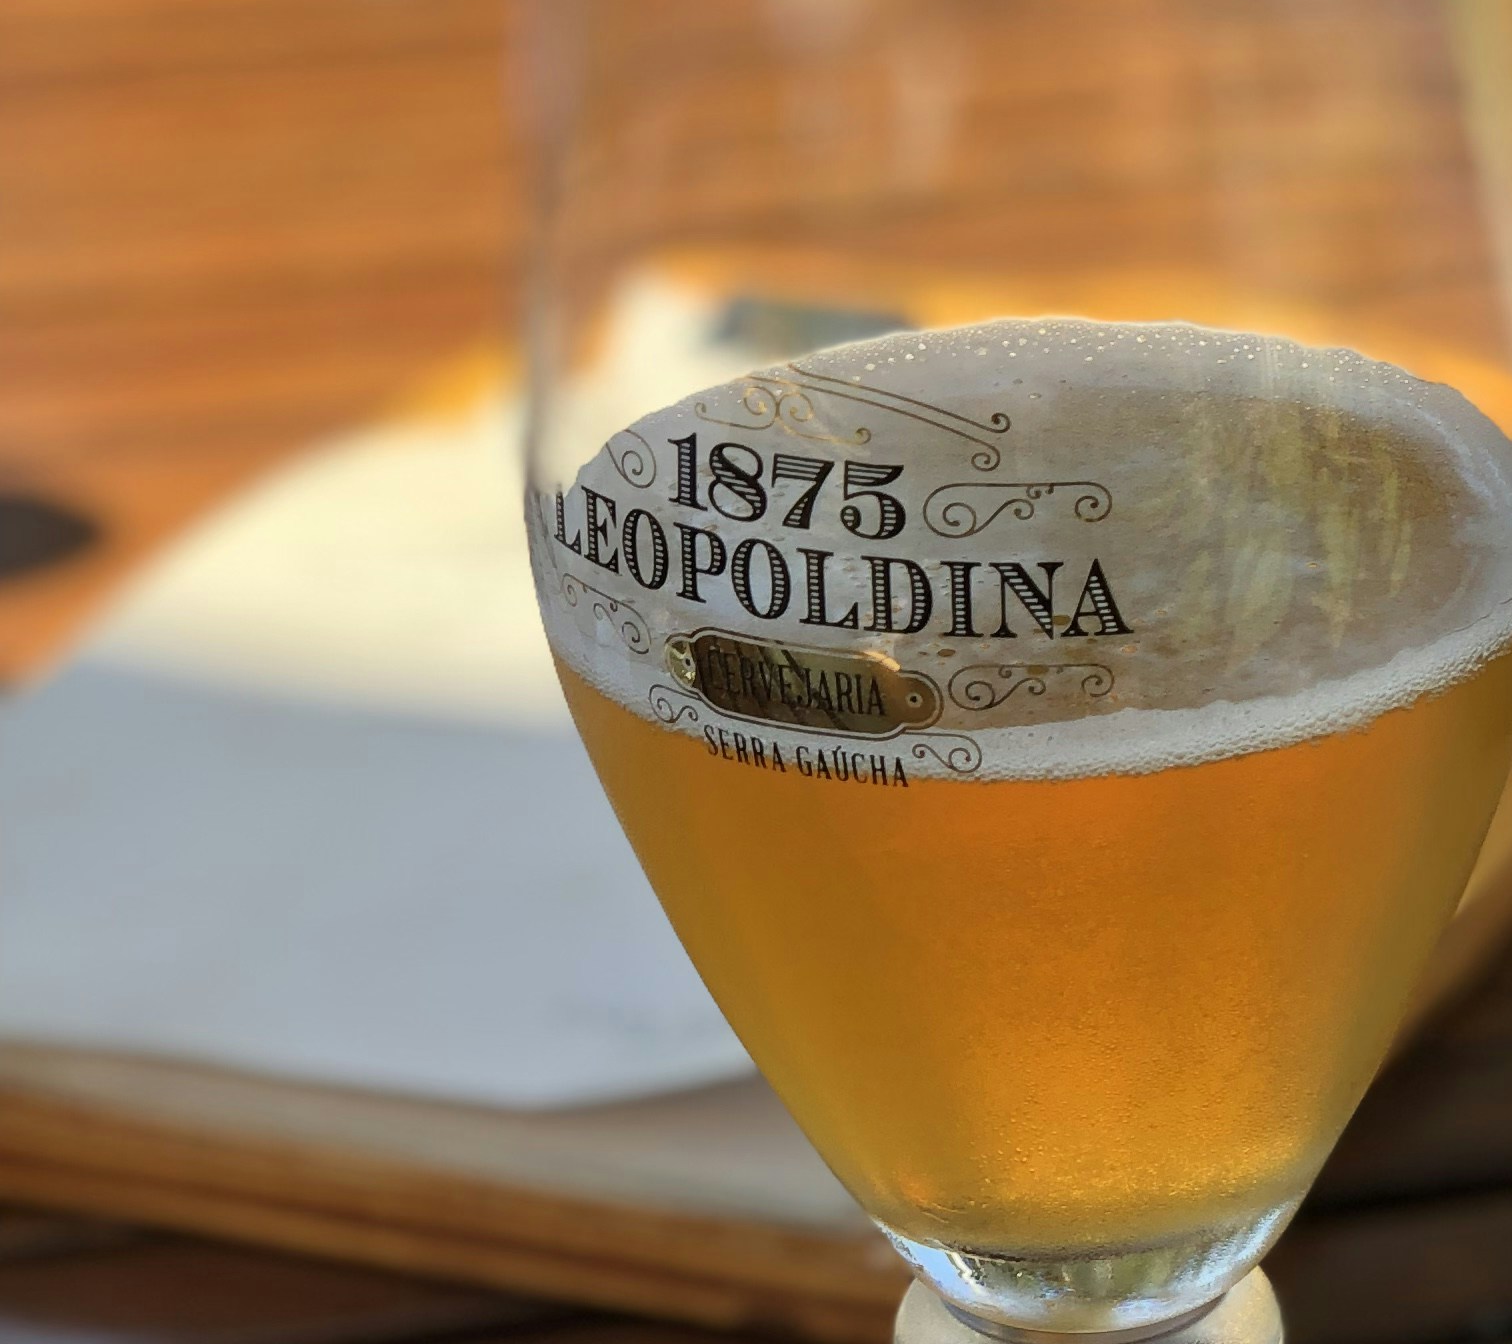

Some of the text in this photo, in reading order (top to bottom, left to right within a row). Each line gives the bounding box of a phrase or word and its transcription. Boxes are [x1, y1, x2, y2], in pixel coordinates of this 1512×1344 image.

[667, 432, 906, 540] 1875
[553, 484, 1133, 639] LEOPOLDINA
[708, 646, 886, 717] CERVEJARIA
[704, 724, 909, 788] SERRA GAÚCHA
